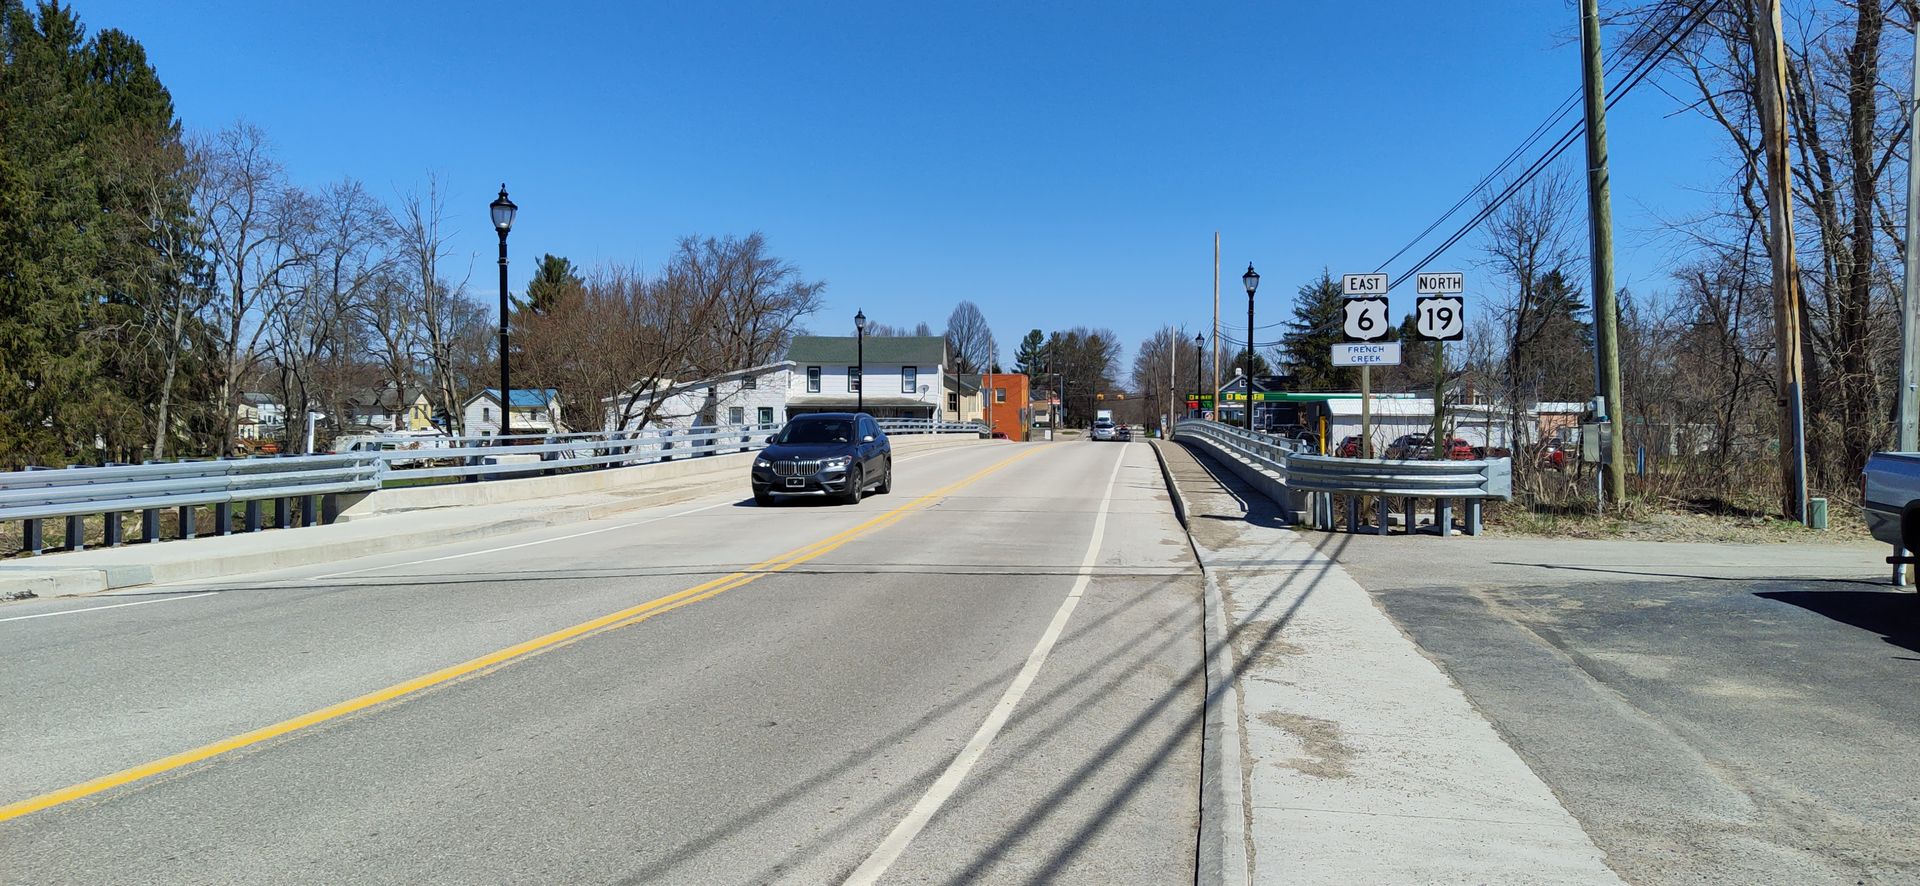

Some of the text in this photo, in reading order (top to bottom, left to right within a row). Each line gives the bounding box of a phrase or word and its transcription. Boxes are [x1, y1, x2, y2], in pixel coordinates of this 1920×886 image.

[1350, 277, 1380, 291] EAST
[1419, 277, 1461, 290] NORTH
[1358, 308, 1374, 331] 6
[1427, 307, 1453, 331] 19
[1351, 355, 1381, 363] CREEK
